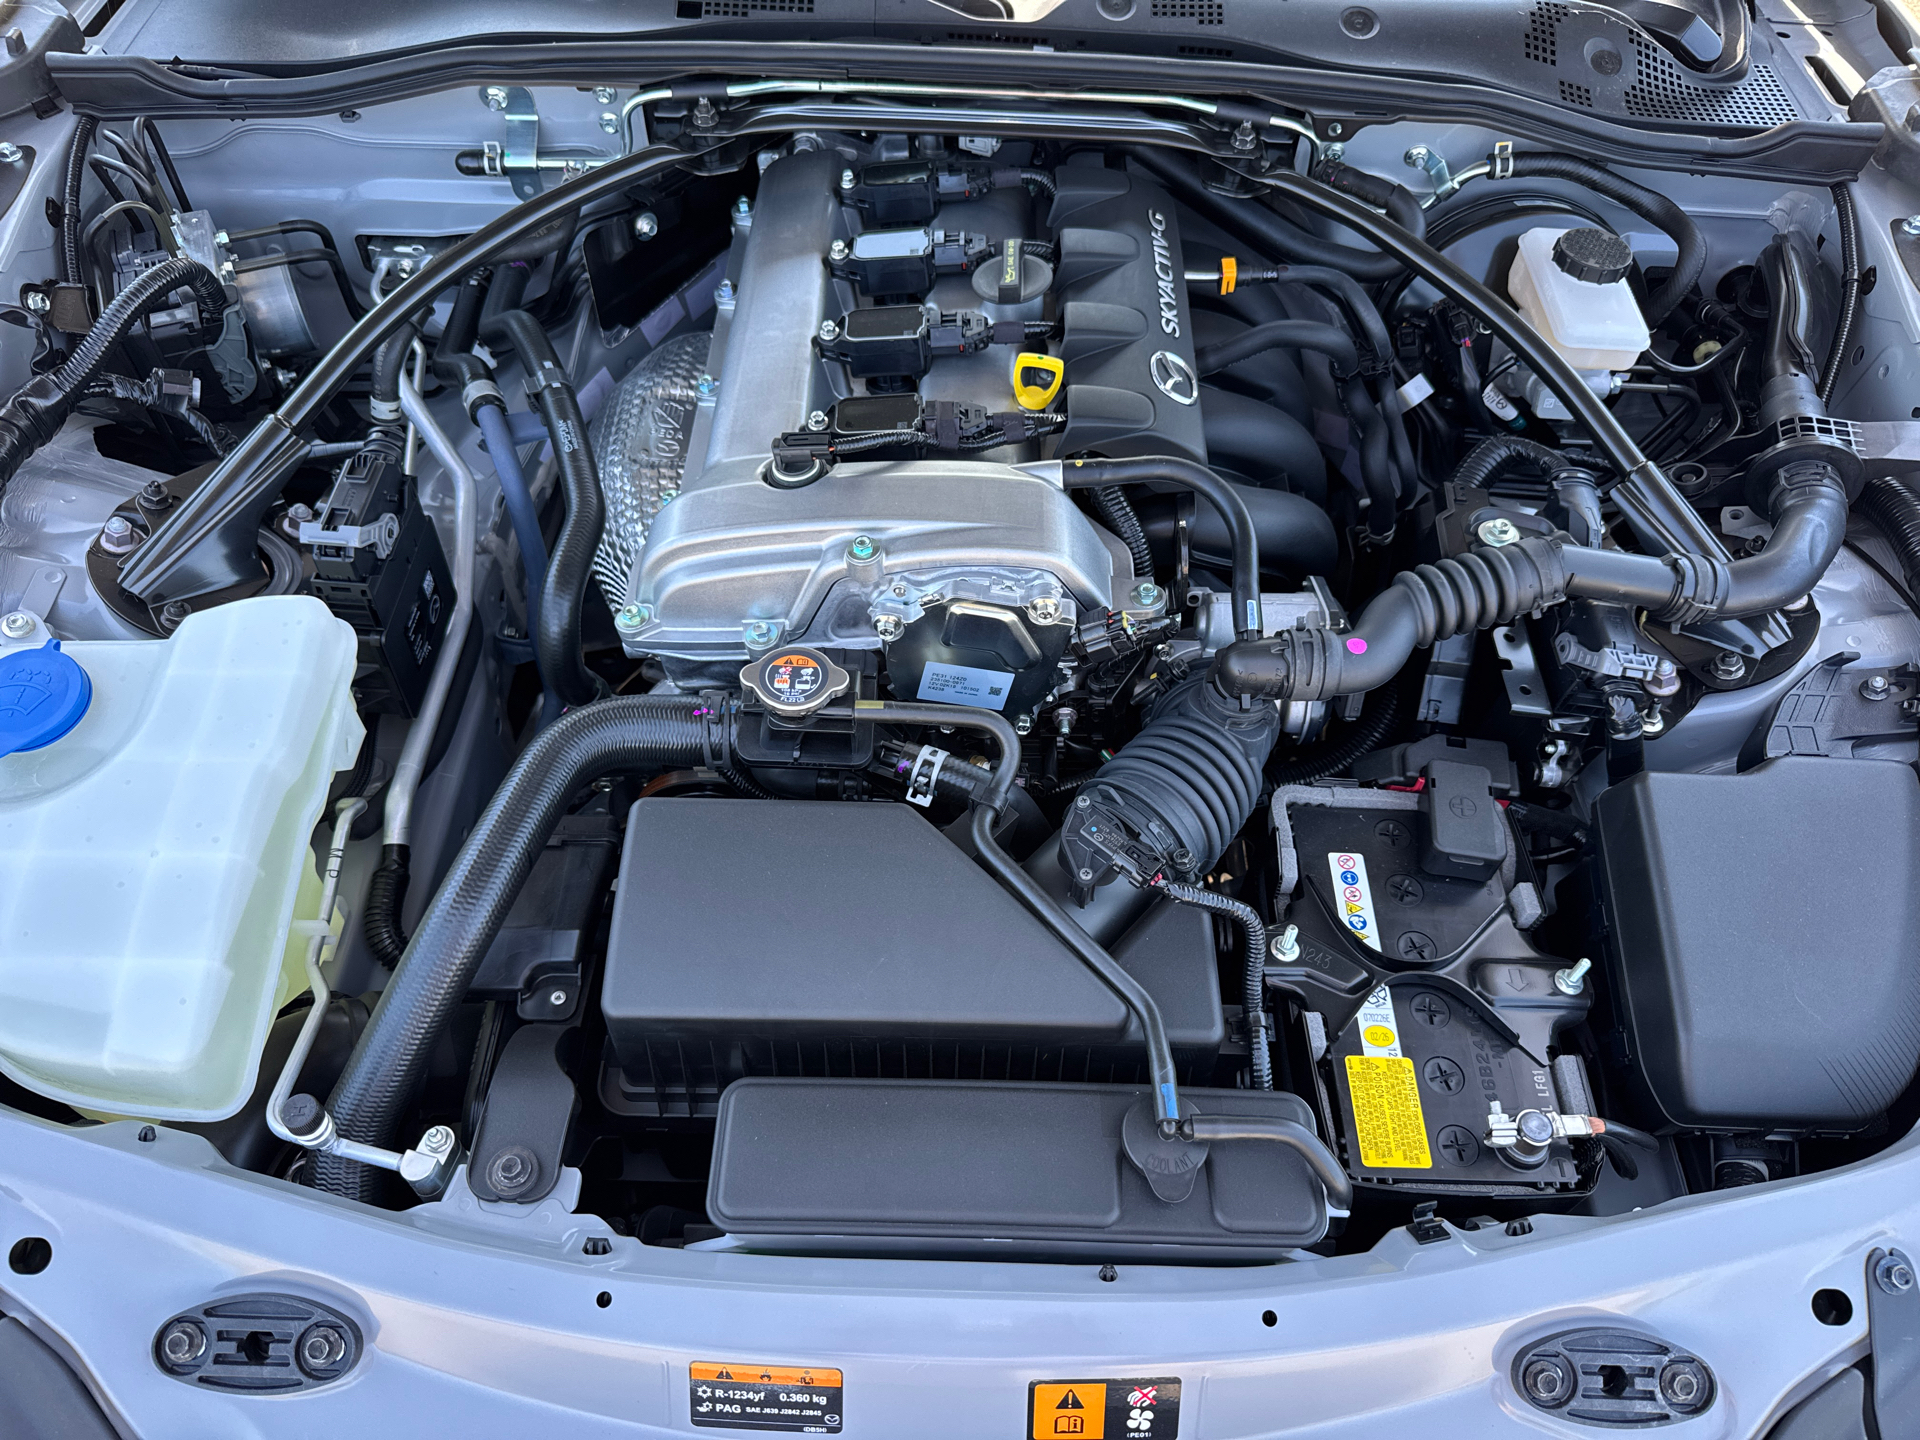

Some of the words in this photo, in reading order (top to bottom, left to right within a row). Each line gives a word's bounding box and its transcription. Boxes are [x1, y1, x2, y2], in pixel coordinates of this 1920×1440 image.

[1148, 208, 1180, 338] SKYACTIV-G
[1372, 1072, 1385, 1098] POISON
[1405, 1076, 1419, 1108] DANGER
[1531, 1069, 1549, 1097] LFG1
[1377, 1100, 1386, 1119] CAUSES
[1381, 1071, 1389, 1083] KEEP
[1385, 1097, 1393, 1110] CAPS
[1390, 1126, 1398, 1136] AND
[1380, 1120, 1389, 1139] SEVERE
[1411, 1110, 1422, 1136] EXPLOSIVE
[1416, 1137, 1425, 1154] GASES
[1145, 1152, 1195, 1173] COOLANT
[715, 1389, 765, 1401] R-1234yf
[779, 1392, 810, 1403] 0.360
[812, 1394, 827, 1405] kg
[715, 1403, 741, 1413] PAG
